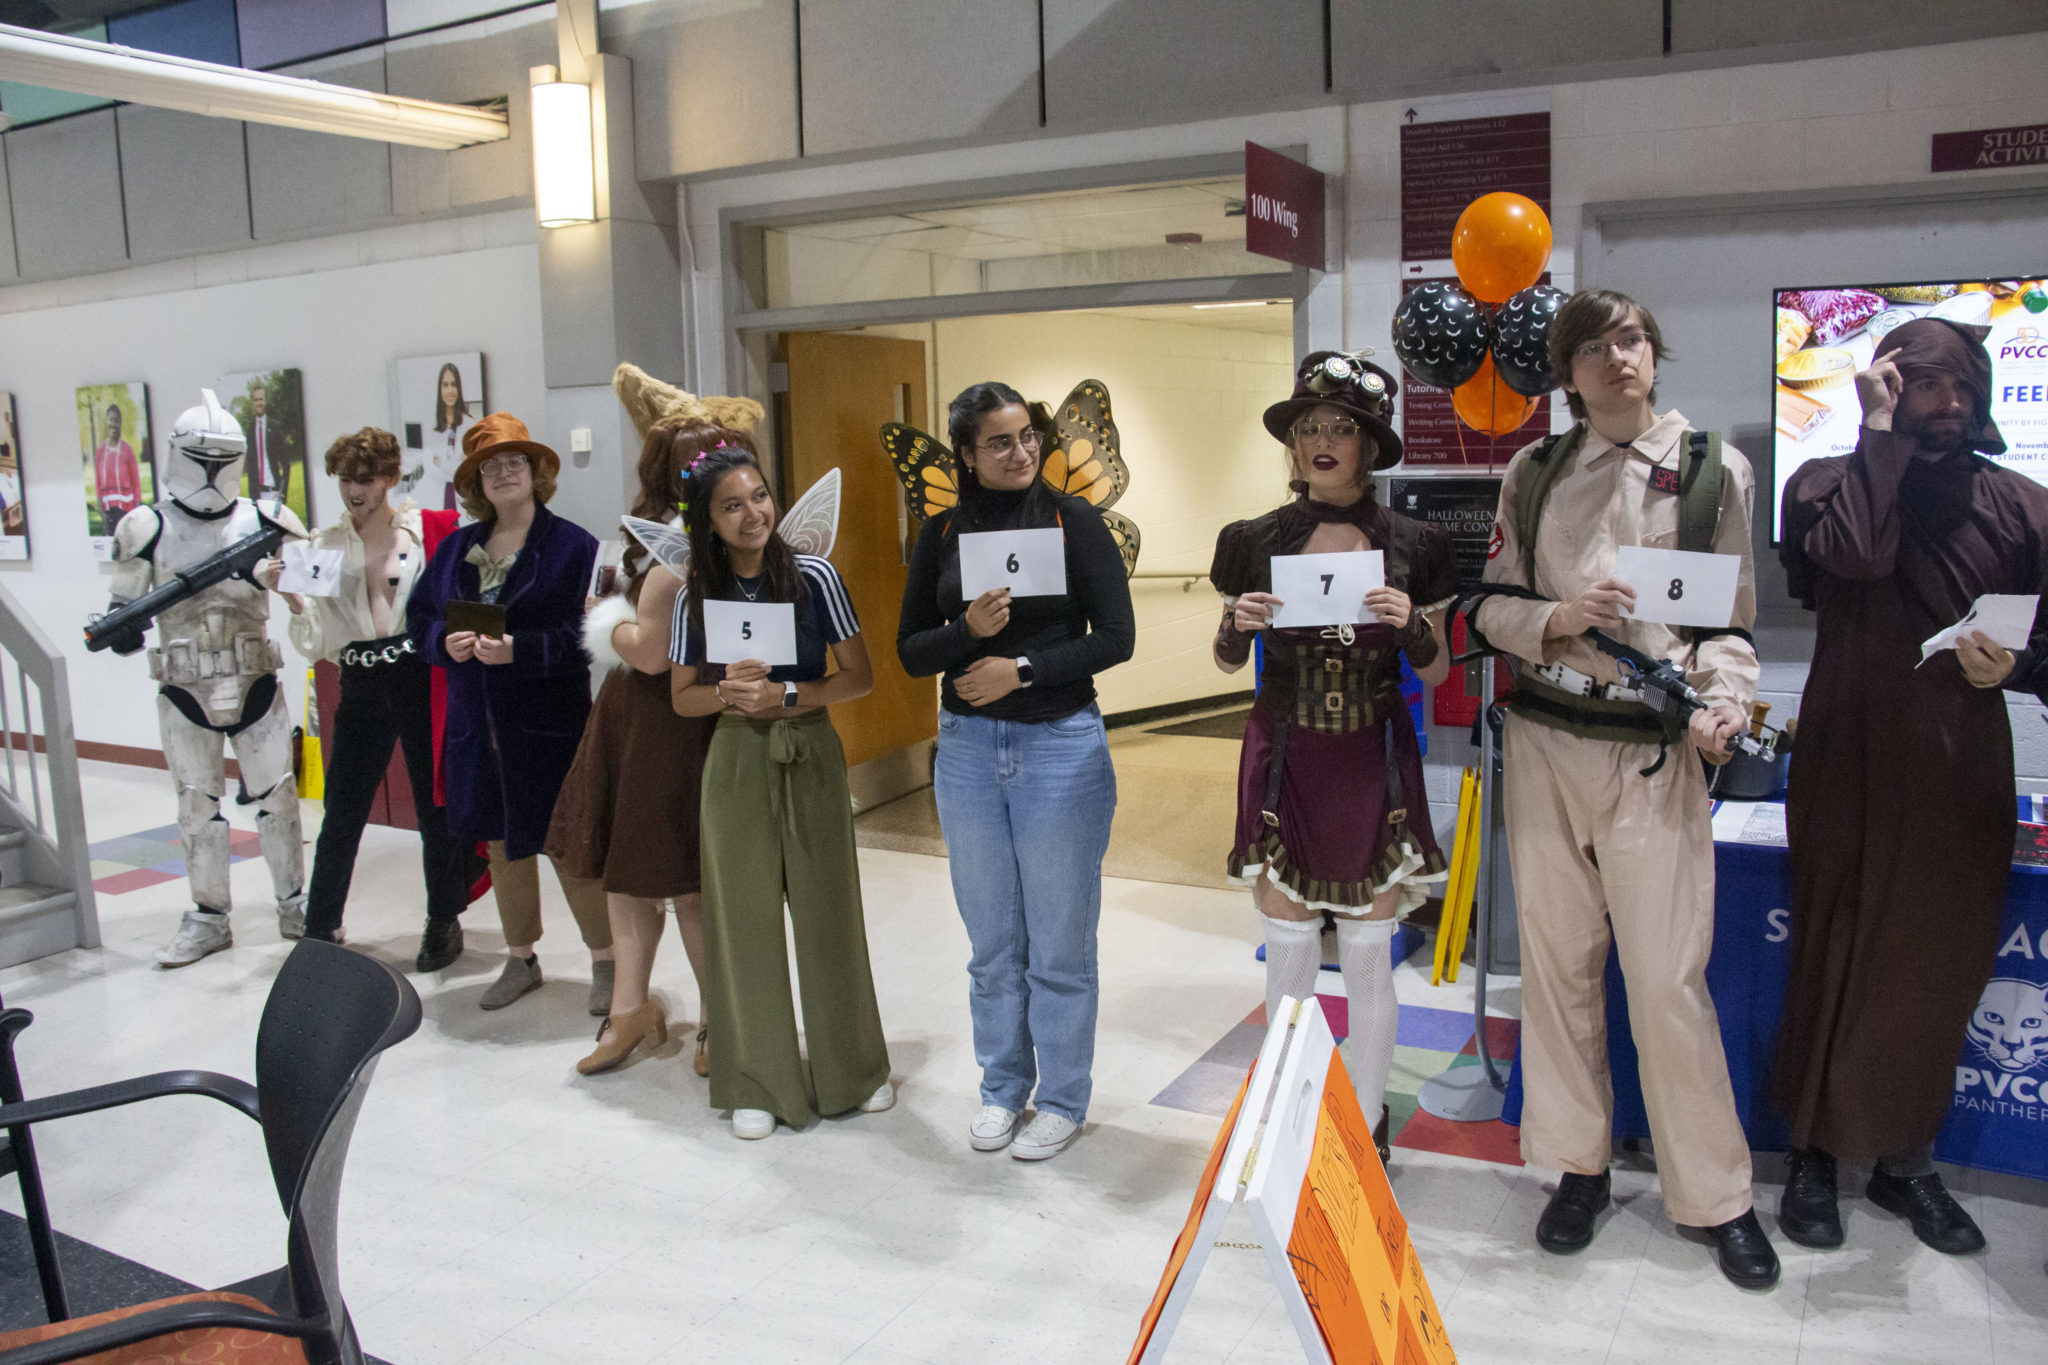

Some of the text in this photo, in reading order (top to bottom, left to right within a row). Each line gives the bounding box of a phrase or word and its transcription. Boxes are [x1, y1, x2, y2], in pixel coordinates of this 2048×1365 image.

[1983, 129, 2048, 149] STUDE
[1405, 144, 1436, 153] Financial
[1438, 143, 1450, 151] Aid
[1442, 159, 1469, 168] Science
[1251, 192, 1299, 239] 100 Wing
[1999, 344, 2048, 360] PVCC
[2003, 385, 2048, 403] FEE
[1409, 402, 1433, 410] Testing
[1408, 419, 1434, 428] Writing
[1408, 451, 1433, 461] Library
[1427, 509, 1495, 521] HALLOWEEN
[1006, 552, 1020, 574] 6
[311, 565, 321, 579] 2
[1320, 573, 1335, 596] 7
[1667, 578, 1684, 601] 8
[741, 620, 752, 640] 5
